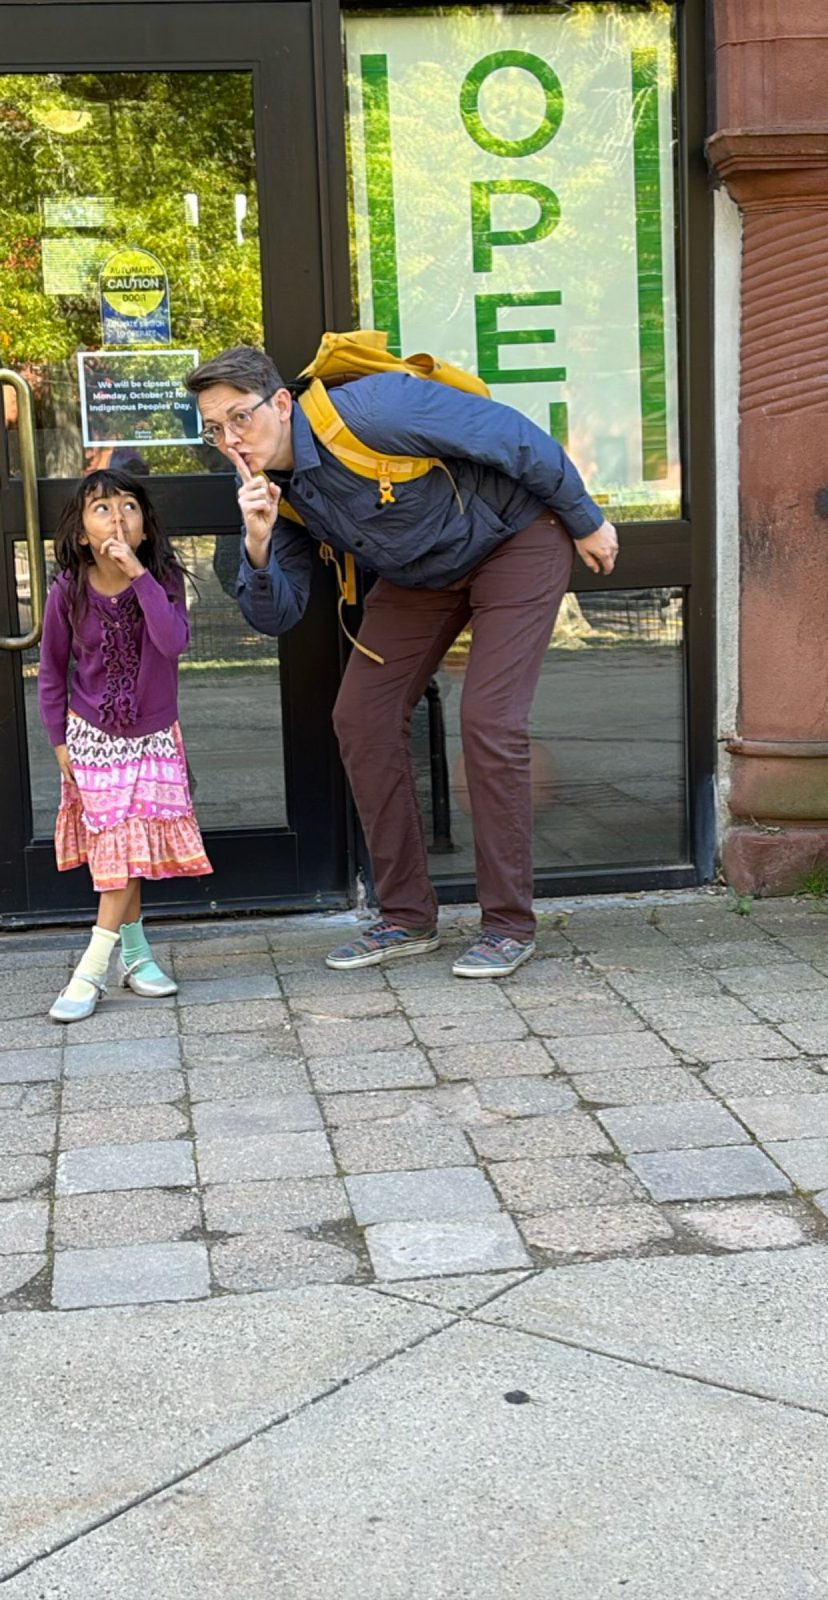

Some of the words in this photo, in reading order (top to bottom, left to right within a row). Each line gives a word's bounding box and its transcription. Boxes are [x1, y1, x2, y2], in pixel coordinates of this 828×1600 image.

[109, 266, 155, 274] AUTOMATIC
[107, 278, 159, 289] CAUTION
[114, 380, 129, 388] will
[131, 380, 142, 388] be
[143, 380, 170, 388] closed
[129, 390, 163, 399] October
[175, 390, 187, 398] for
[89, 403, 137, 412] Indigenous
[174, 402, 193, 411] Day.
